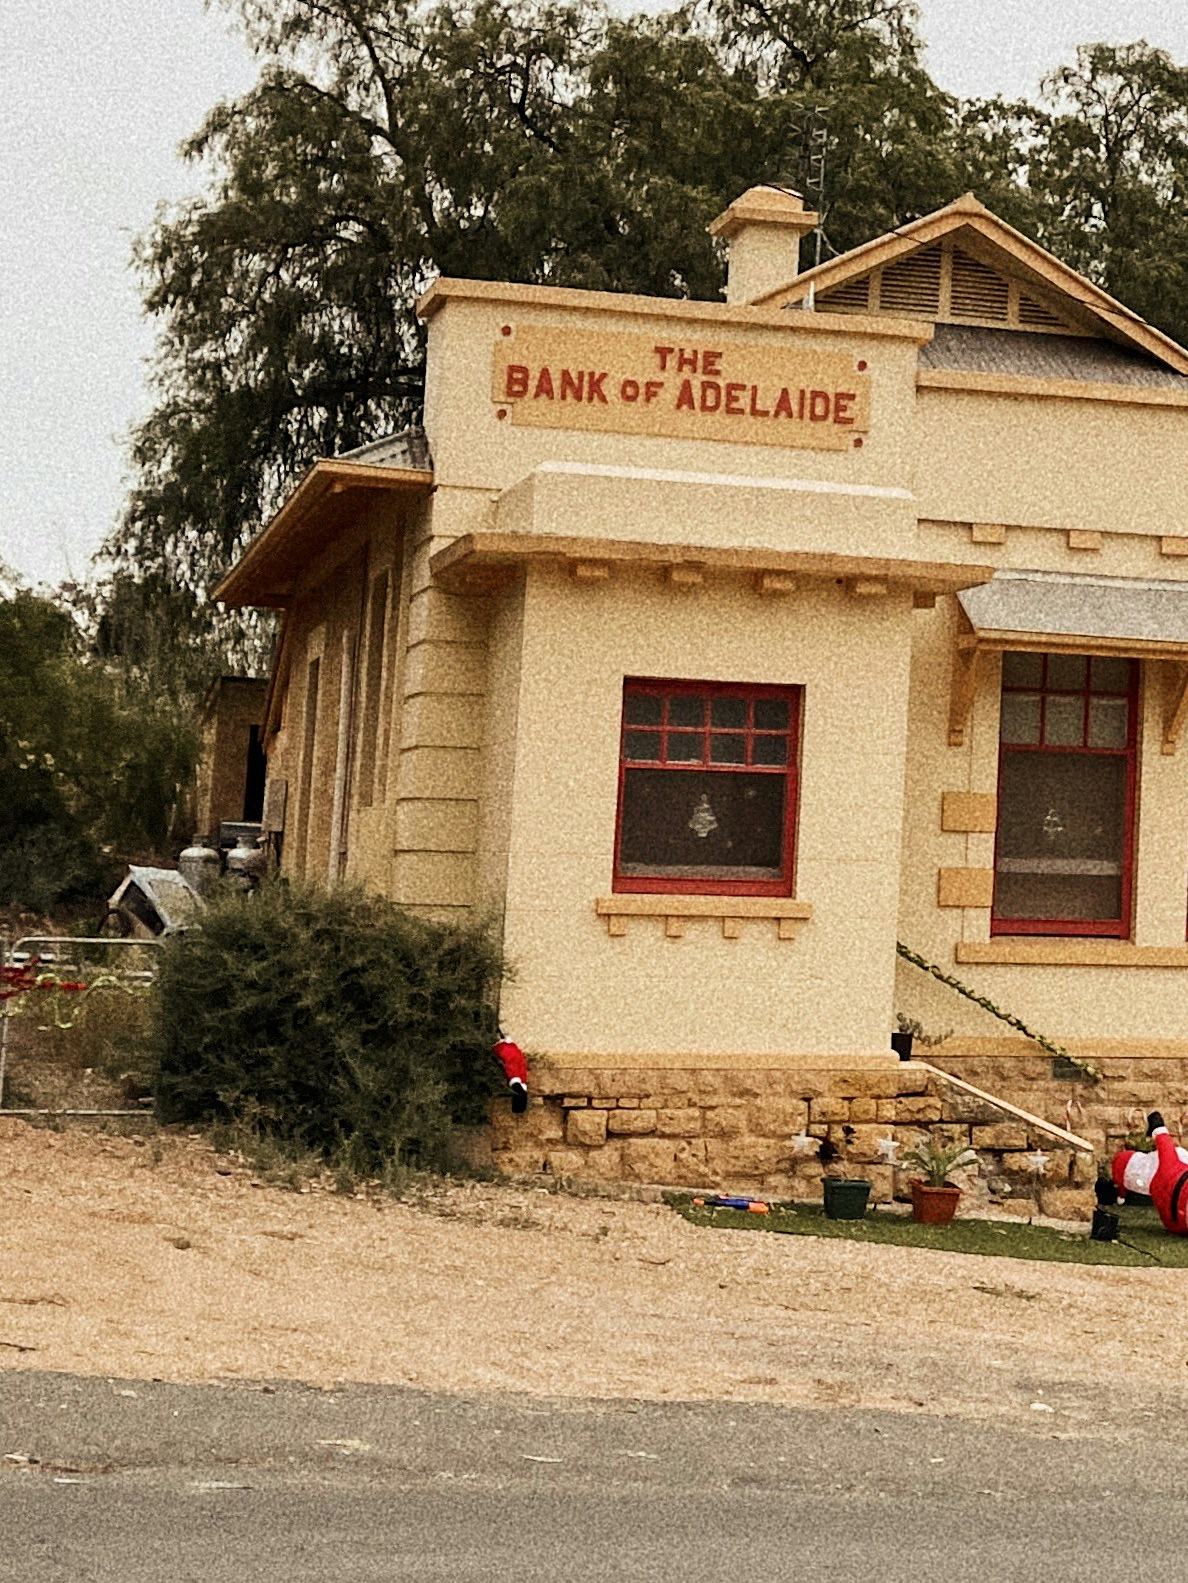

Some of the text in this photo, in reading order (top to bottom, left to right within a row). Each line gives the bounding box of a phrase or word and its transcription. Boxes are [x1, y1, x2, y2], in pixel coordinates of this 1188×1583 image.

[653, 345, 723, 377] THE
[504, 364, 856, 426] BANK OF ADELAIDE
